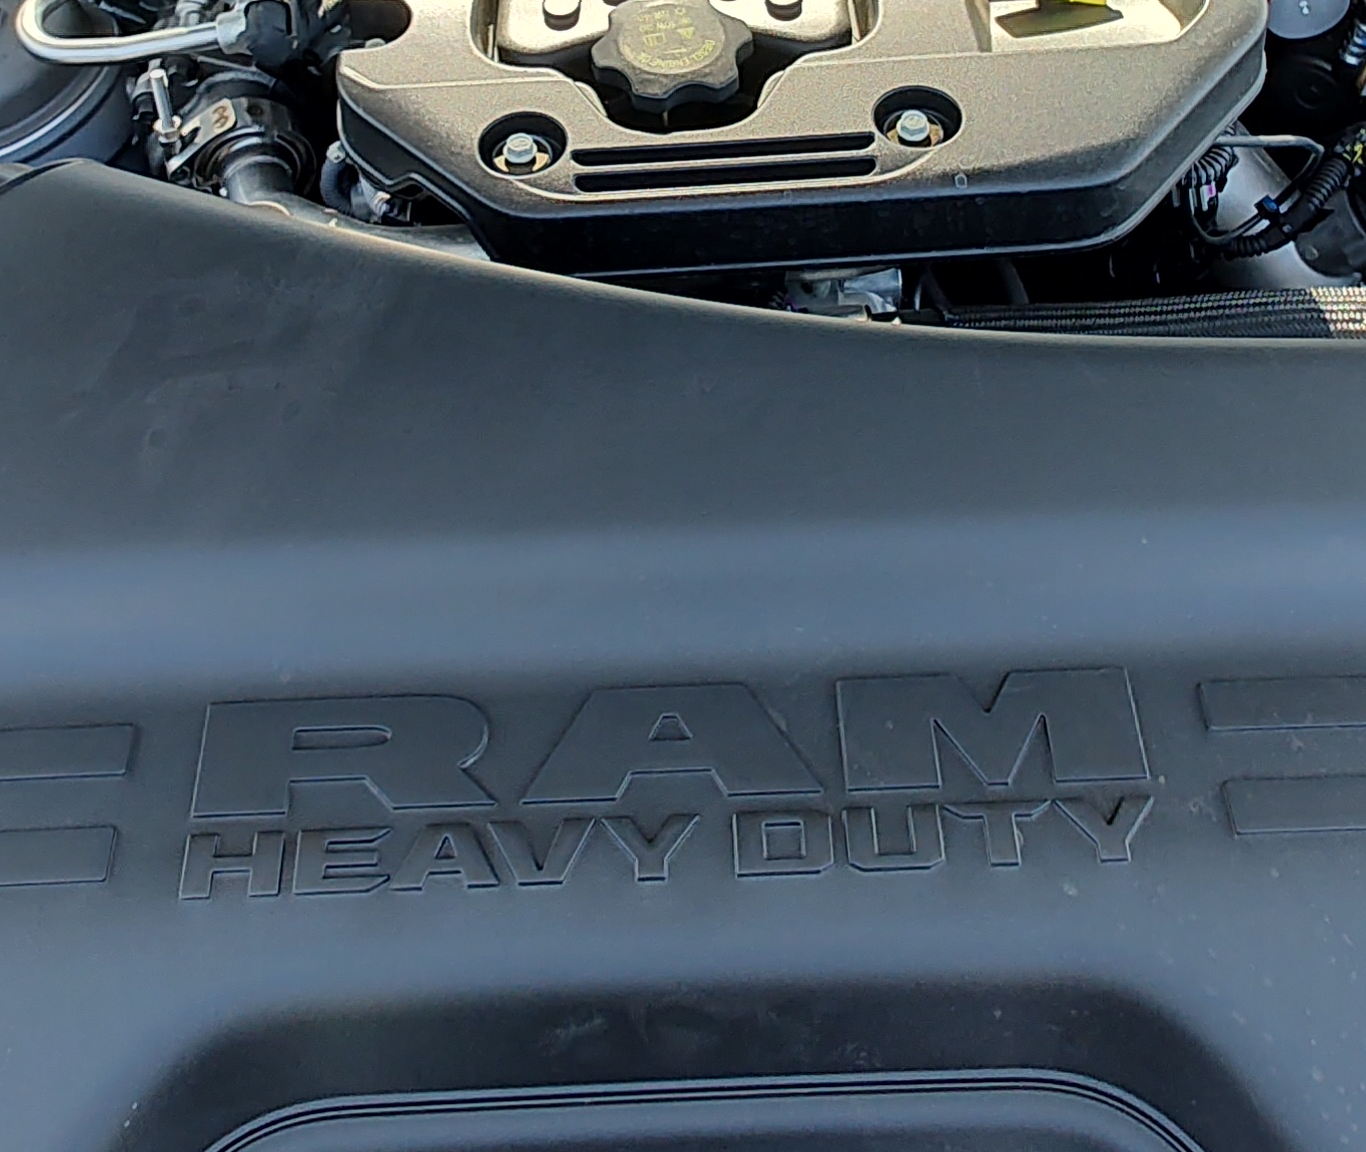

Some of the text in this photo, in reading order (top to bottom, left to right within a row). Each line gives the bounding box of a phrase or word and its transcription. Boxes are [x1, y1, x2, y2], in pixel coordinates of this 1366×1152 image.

[190, 666, 1150, 818] RAM
[179, 795, 1154, 900] HEAVY DUTY
